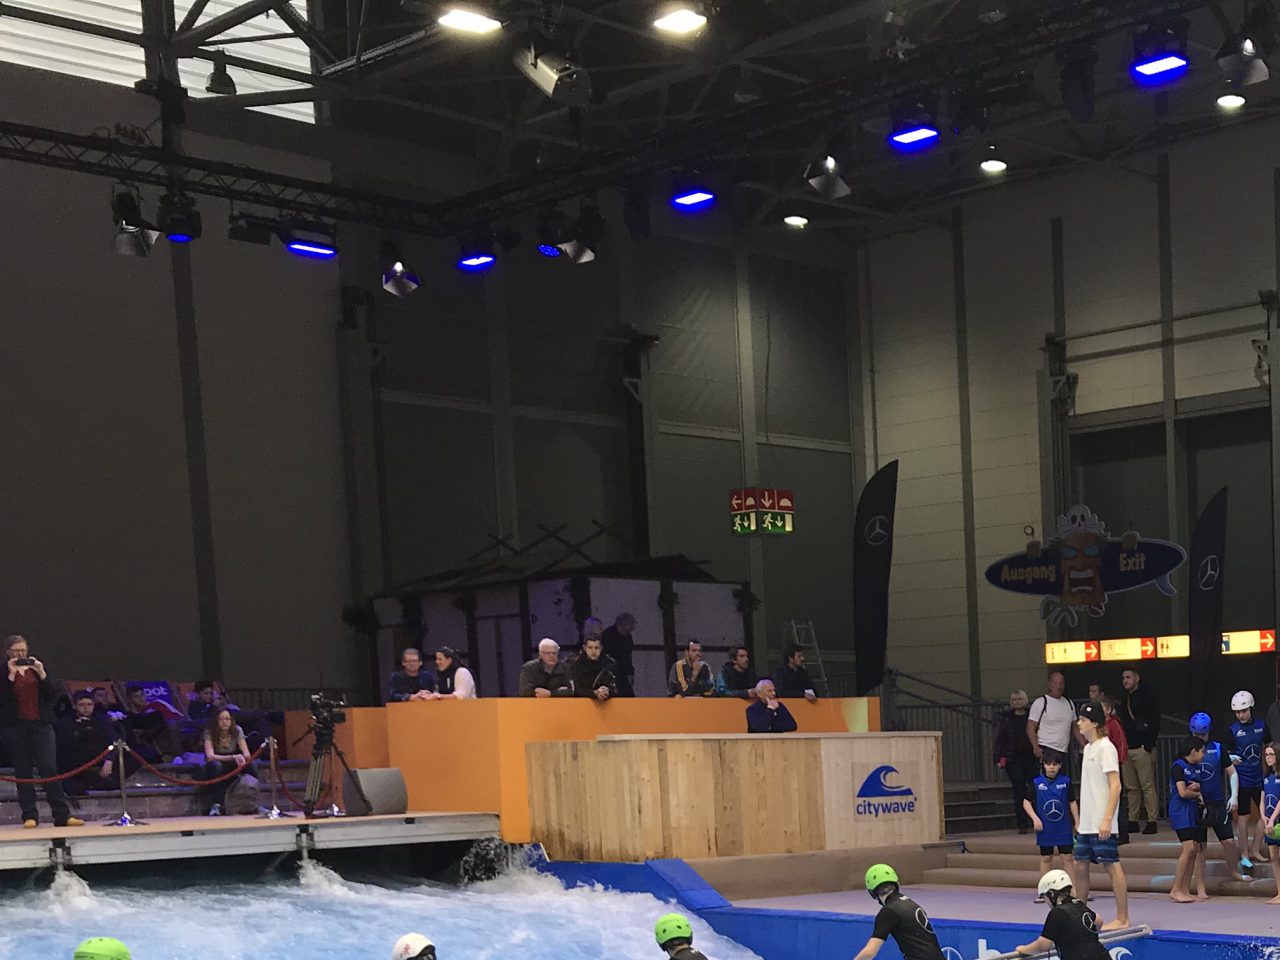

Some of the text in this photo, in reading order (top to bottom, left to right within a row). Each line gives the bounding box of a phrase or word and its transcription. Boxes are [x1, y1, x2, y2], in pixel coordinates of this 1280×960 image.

[1119, 553, 1146, 572] Exit
[1001, 564, 1056, 584] Ausgang
[856, 799, 916, 818] citywave
